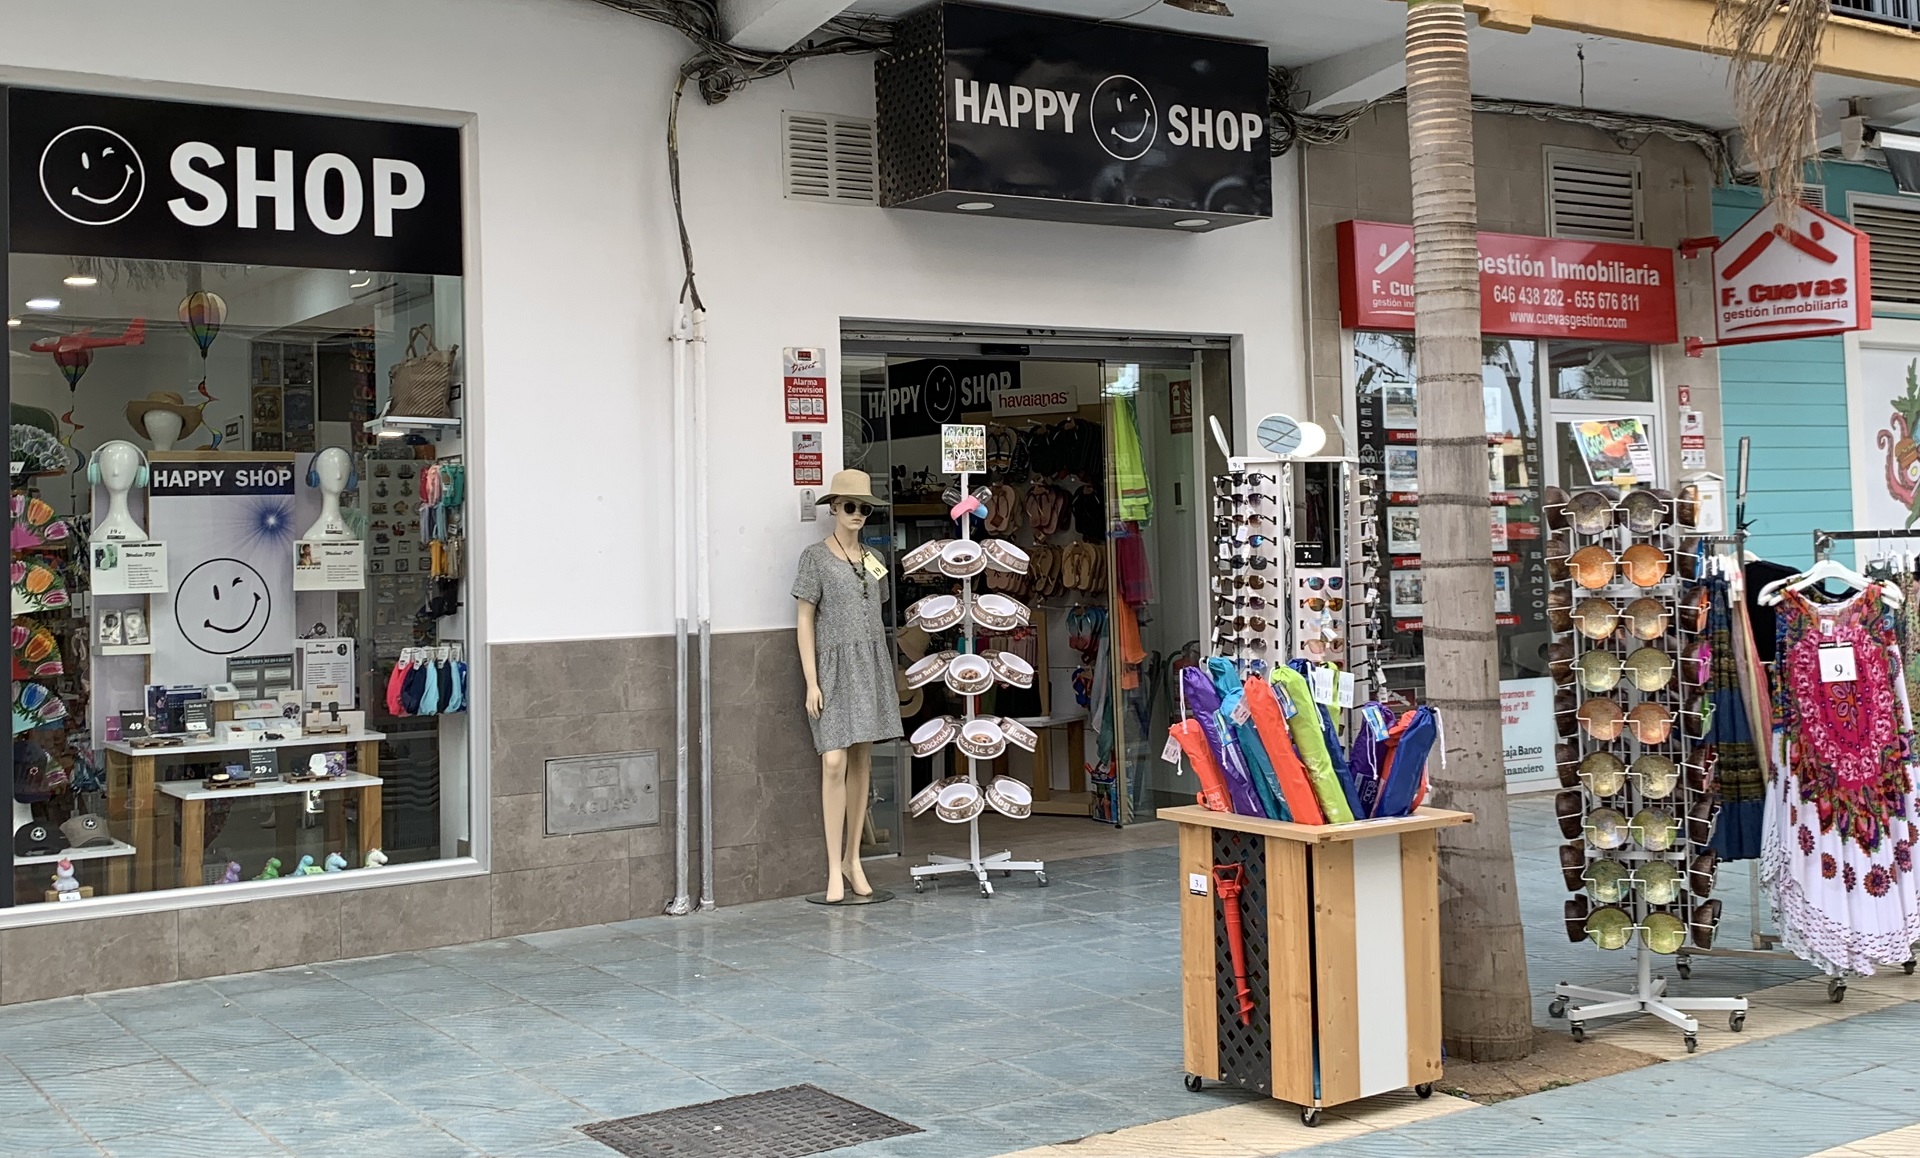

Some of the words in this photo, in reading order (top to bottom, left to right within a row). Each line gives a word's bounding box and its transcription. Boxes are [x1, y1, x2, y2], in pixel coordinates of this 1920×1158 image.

[954, 78, 1080, 134] HAPPY
[1167, 104, 1263, 152] SHOP
[167, 141, 426, 238] SHOP
[1551, 256, 1660, 286] Inmobiliaria
[1371, 279, 1385, 295] F.
[1722, 287, 1743, 306] F.
[1748, 278, 1848, 303] Cuevas
[1493, 286, 1515, 303] 646
[1519, 287, 1540, 305] 438
[1543, 288, 1564, 307] 282
[1574, 292, 1596, 309] 655
[1598, 293, 1619, 310] 676
[1621, 294, 1640, 312] 811
[1723, 306, 1769, 322] gestión
[1773, 299, 1848, 316] inmobiliaria
[1510, 311, 1627, 330] www.cuevasgestion.com
[787, 385, 824, 394] Zerovision
[793, 378, 818, 386] Alarma
[1593, 375, 1629, 387] Cuevas
[868, 384, 921, 419] HAPPY
[998, 391, 1067, 409] havaianas
[154, 470, 224, 487] HAPPY
[235, 469, 292, 487] SHOP
[1531, 551, 1545, 621] BANCOS
[1834, 664, 1844, 677] 9
[1518, 746, 1543, 755] Banco
[255, 765, 267, 774] 29
[1504, 764, 1544, 775] inanciero
